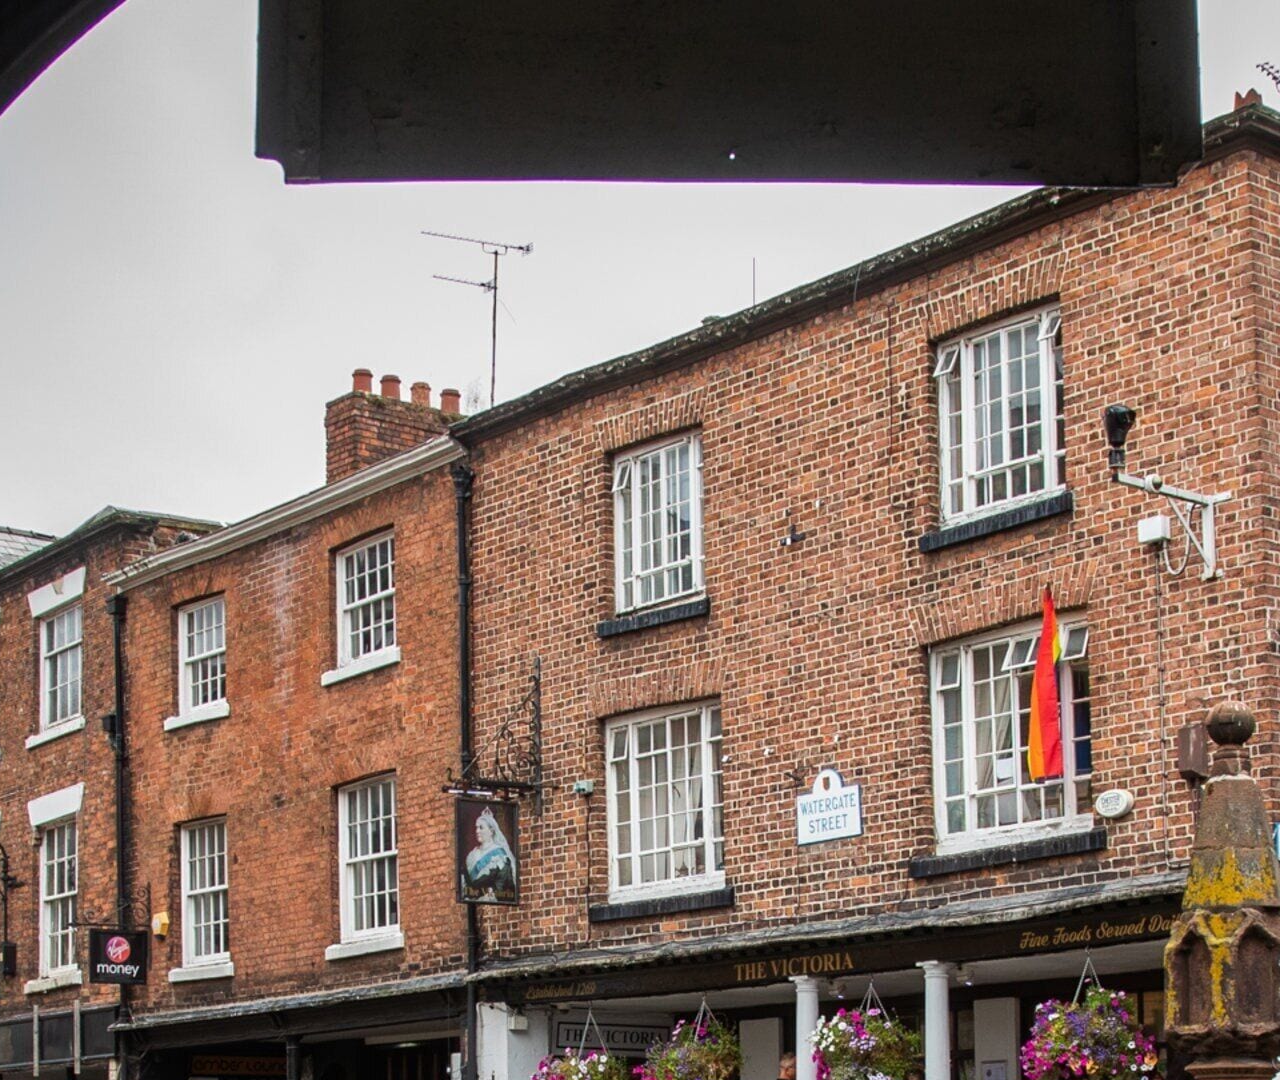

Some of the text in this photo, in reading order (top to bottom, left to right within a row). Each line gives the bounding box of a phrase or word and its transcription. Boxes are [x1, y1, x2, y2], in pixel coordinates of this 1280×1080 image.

[800, 793, 857, 816] WATERGATE
[809, 814, 848, 834] STREET
[1020, 932, 1049, 949] Fine
[1053, 926, 1092, 945] Foods
[1096, 917, 1146, 940] Served
[97, 964, 139, 977] money
[735, 952, 854, 981] THE VICTORIA
[564, 1028, 592, 1043] THE
